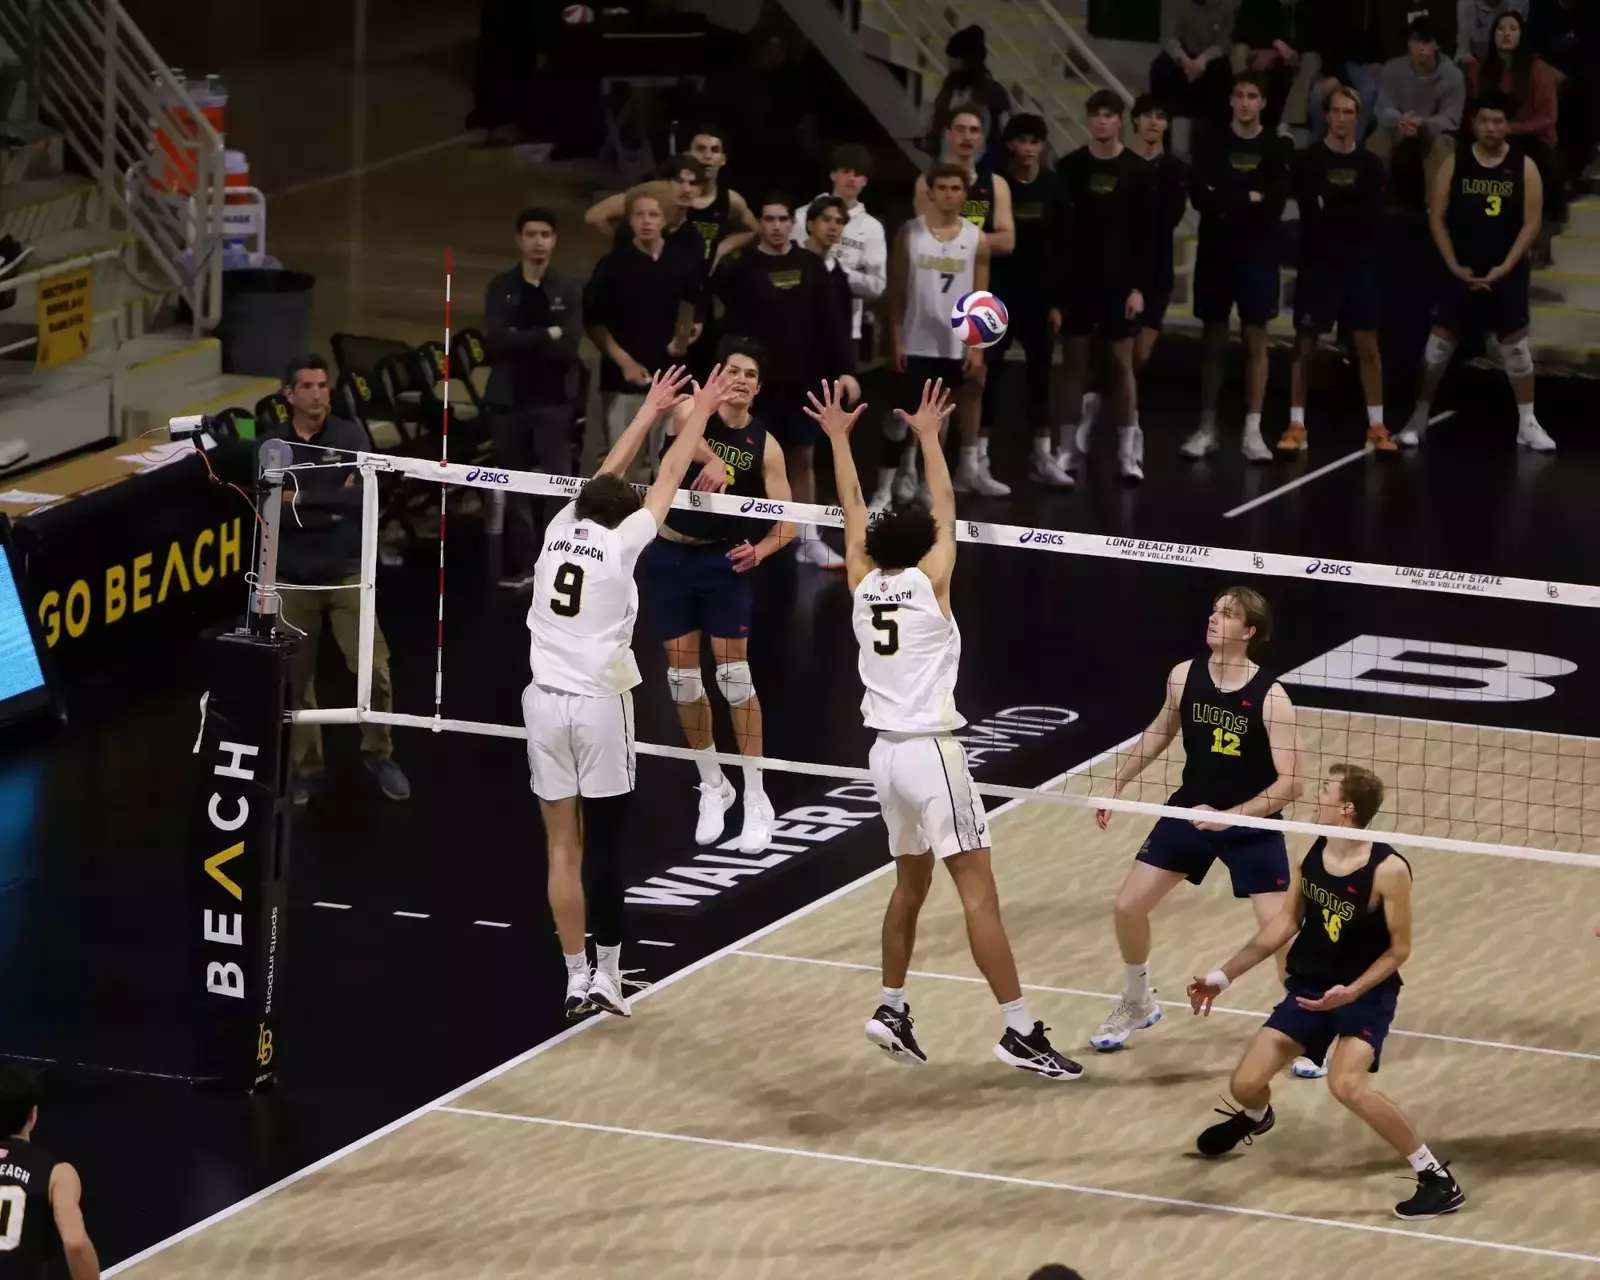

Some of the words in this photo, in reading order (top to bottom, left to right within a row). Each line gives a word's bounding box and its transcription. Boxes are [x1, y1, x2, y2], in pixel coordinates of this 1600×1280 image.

[1462, 178, 1514, 197] LIONS
[1484, 194, 1502, 217] 3
[940, 273, 950, 294] 7
[549, 476, 577, 487] LONG
[824, 507, 844, 517] LON
[548, 540, 572, 552] LONG
[572, 544, 604, 562] BEACH
[1105, 537, 1134, 548] LONG
[1138, 540, 1173, 553] BEACH
[1177, 545, 1212, 557] STATE
[1121, 549, 1145, 557] MEN'S
[1147, 552, 1194, 562] VOLLEYBALL
[38, 579, 91, 649] GO
[105, 517, 241, 624] BEACH
[550, 562, 584, 617] 9
[1395, 567, 1424, 578] LONG
[1428, 570, 1465, 582] BEACH
[1468, 574, 1503, 586] STATE
[1411, 578, 1435, 586] MEN'S
[1438, 581, 1485, 592] VOLLEYBALL
[870, 604, 899, 656] 5
[1276, 634, 1579, 702] B
[1193, 703, 1248, 734] LIONS
[1211, 727, 1241, 757] 12
[203, 740, 259, 999] BEACH
[624, 805, 880, 907] WALTER
[1302, 877, 1355, 921] LIONS
[269, 906, 278, 954] sports
[1322, 908, 1342, 943] 16
[265, 956, 274, 1014] imports
[0, 1163, 30, 1185] EACH
